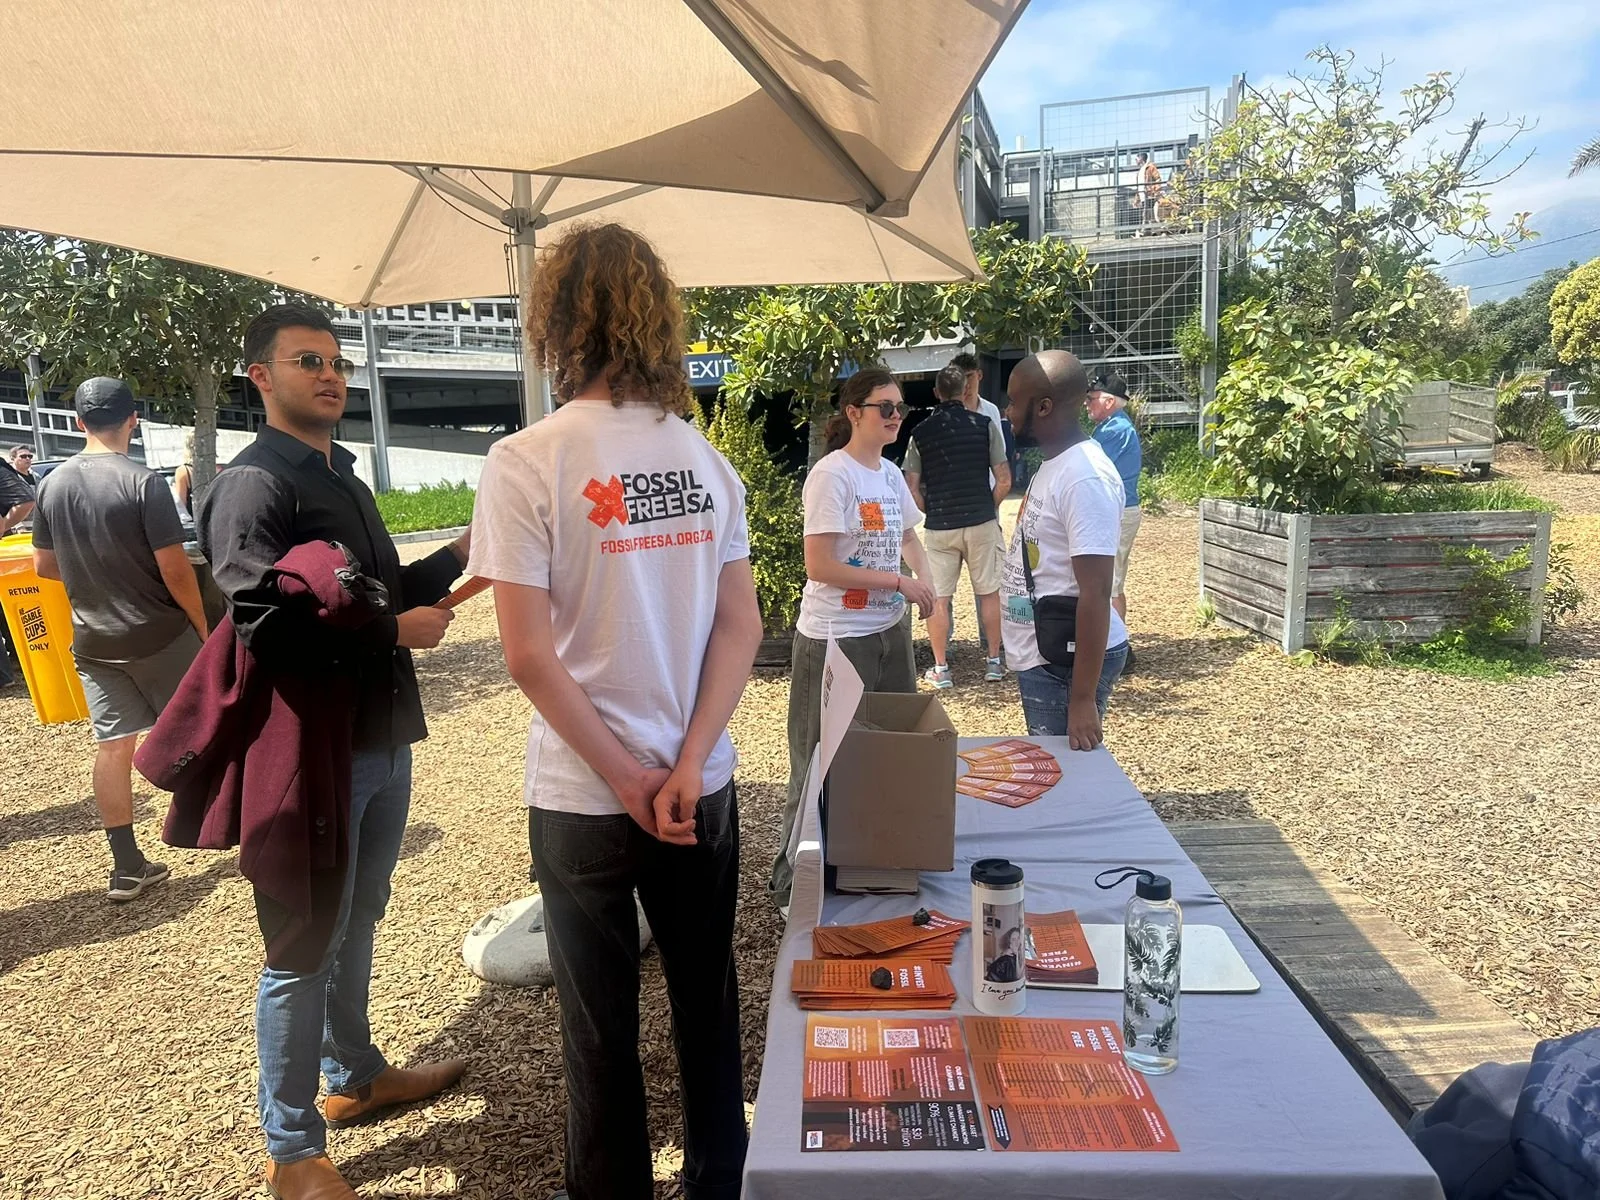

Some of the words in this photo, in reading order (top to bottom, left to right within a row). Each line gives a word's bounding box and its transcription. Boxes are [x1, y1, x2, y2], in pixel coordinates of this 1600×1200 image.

[688, 359, 732, 379] EXIT
[620, 469, 703, 495] FOSSIL
[625, 494, 681, 521] FREE
[687, 492, 715, 514] SA
[8, 586, 40, 596] RETURN
[21, 609, 43, 624] USABLE
[24, 621, 47, 640] CUPS
[29, 642, 49, 651] ONLY
[1036, 960, 1082, 968] #INVEST
[1040, 955, 1075, 963] FOSSIL
[899, 968, 909, 988] FOSSIL
[913, 965, 926, 989] #INVEST
[1070, 1030, 1085, 1048] FREE
[1085, 1028, 1102, 1052] FOSSIL
[1101, 1026, 1121, 1054] #INVEST
[928, 1102, 940, 1118] 90%
[901, 1127, 910, 1147] trillion
[912, 1127, 923, 1140] $30
